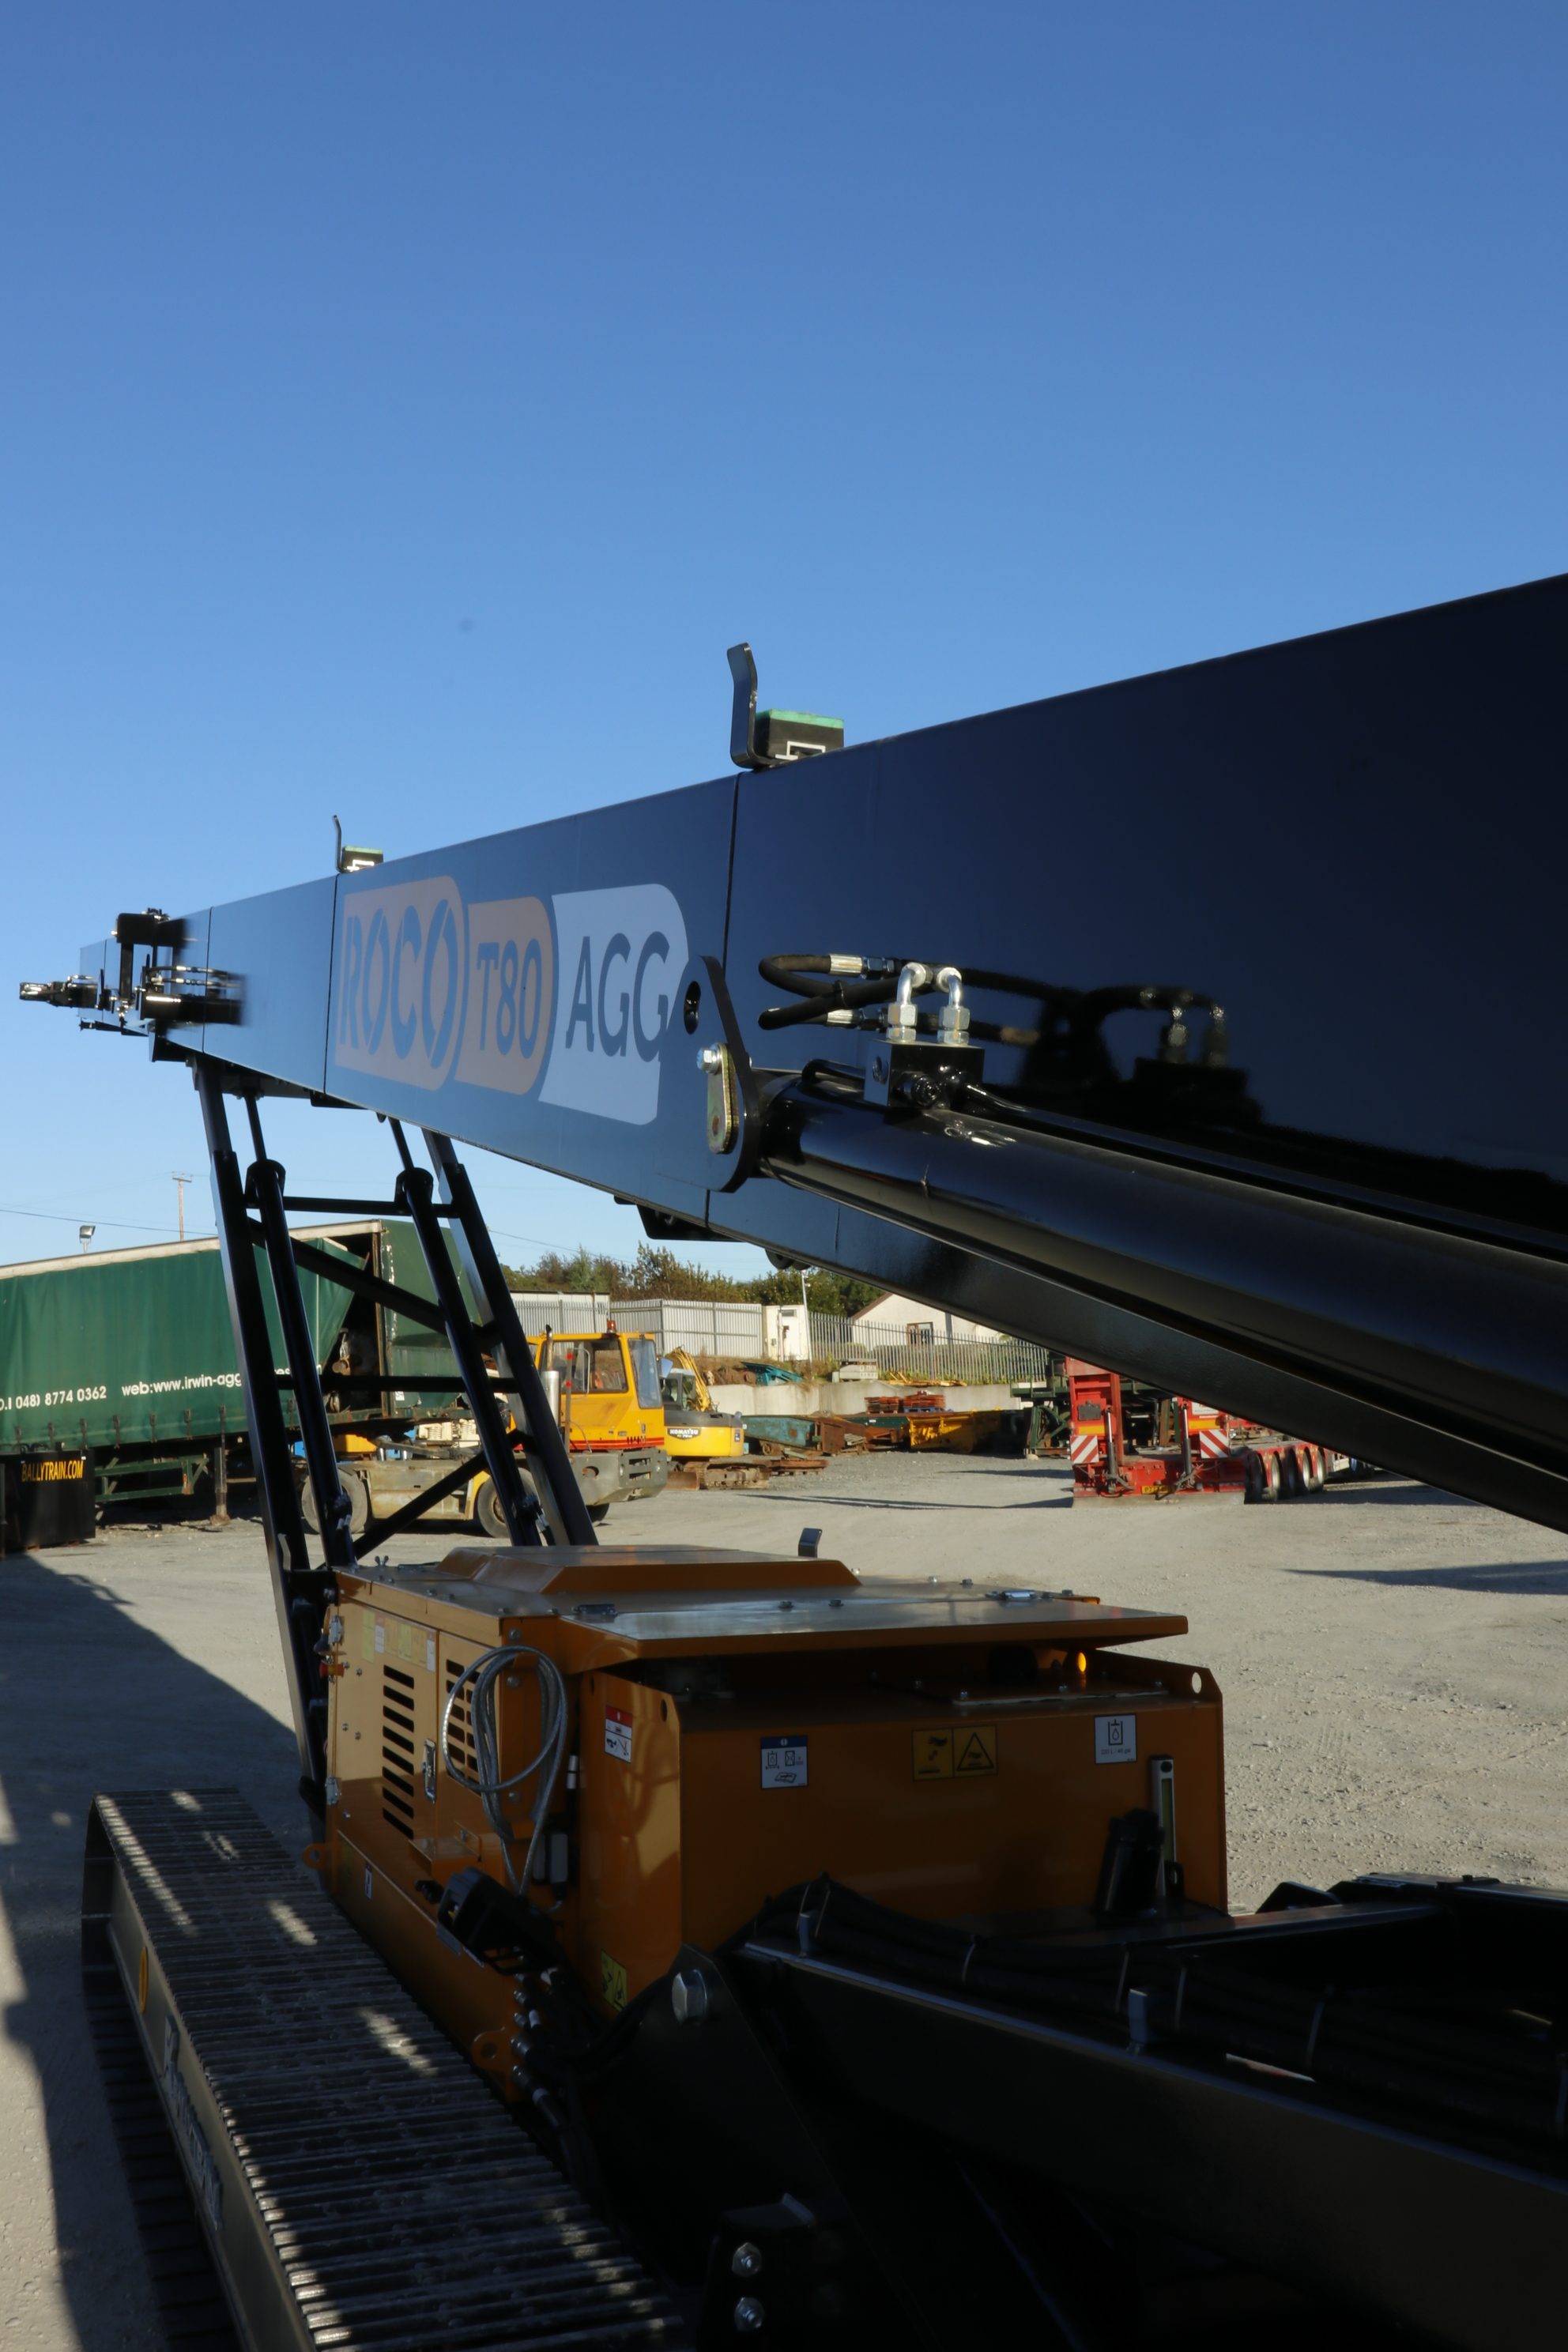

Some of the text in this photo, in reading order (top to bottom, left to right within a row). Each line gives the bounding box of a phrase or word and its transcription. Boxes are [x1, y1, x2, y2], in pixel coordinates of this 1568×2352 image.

[340, 899, 670, 1069] ROCO T80 AGG
[15, 1393, 41, 1409] 048)
[44, 1389, 74, 1406] 8774
[76, 1385, 107, 1402] 0362
[21, 1459, 84, 1482] BALLYTRAIN.COM
